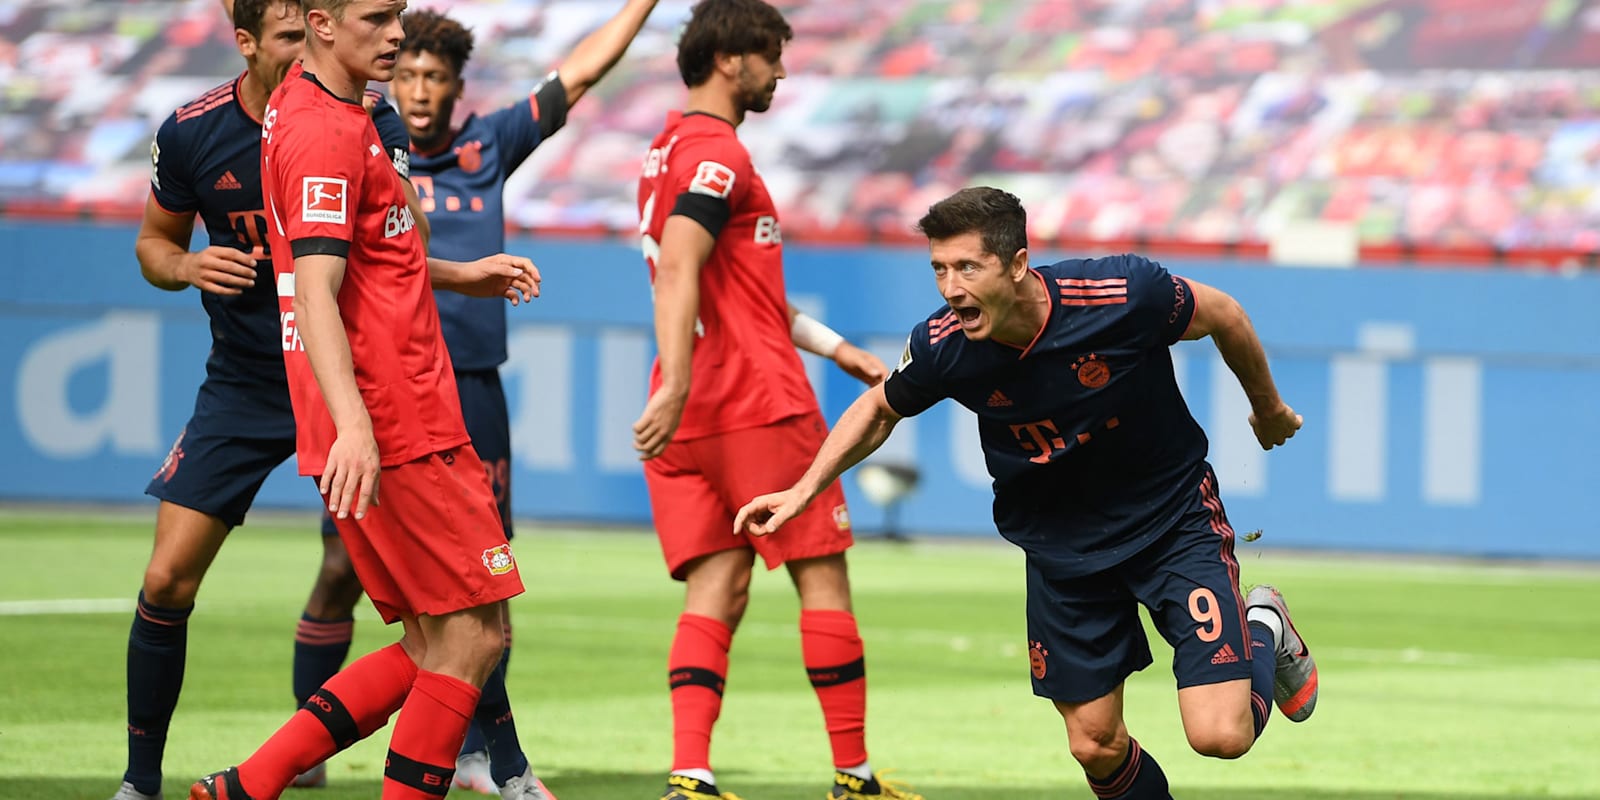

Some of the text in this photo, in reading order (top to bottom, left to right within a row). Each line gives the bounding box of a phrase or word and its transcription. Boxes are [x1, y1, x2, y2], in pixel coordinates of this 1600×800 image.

[305, 212, 342, 220] BUNDESLIGA
[1187, 587, 1223, 642] 9
[1210, 655, 1239, 665] adidas
